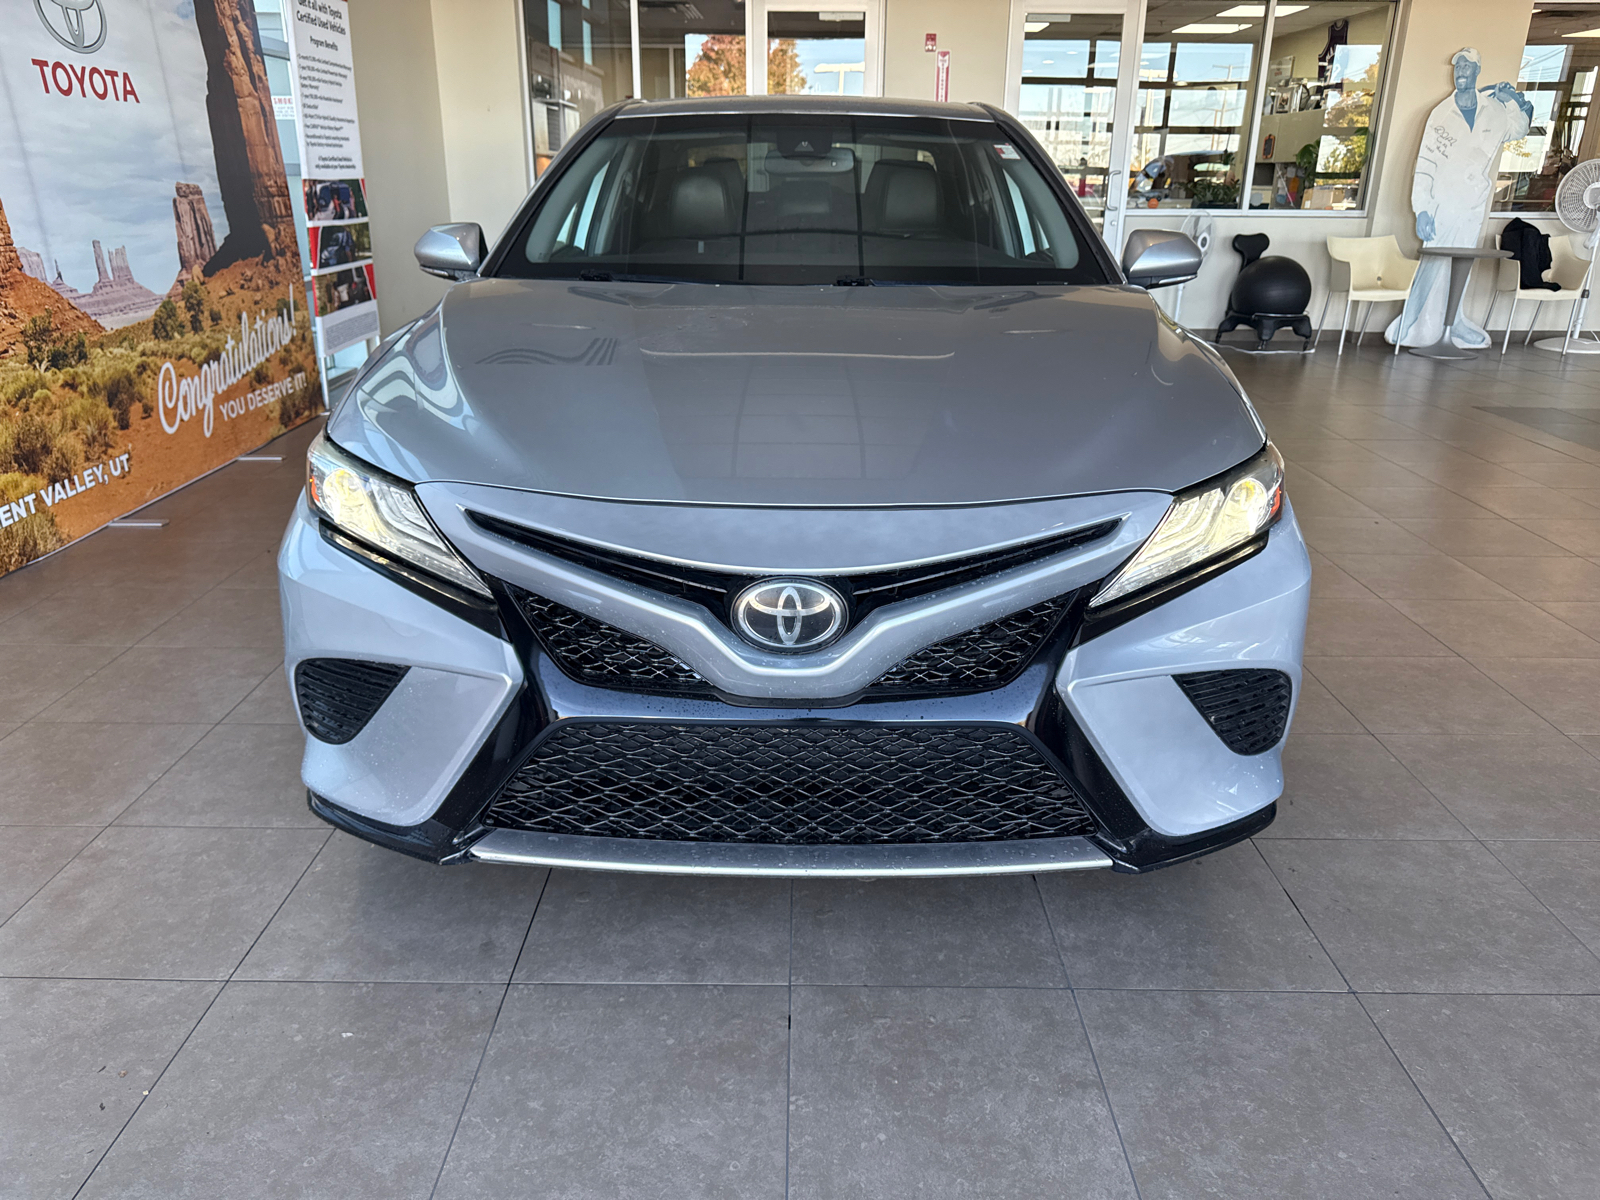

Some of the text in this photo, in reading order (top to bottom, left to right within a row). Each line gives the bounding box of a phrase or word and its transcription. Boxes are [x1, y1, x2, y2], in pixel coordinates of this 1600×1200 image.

[296, 10, 317, 26] Certified
[329, 20, 346, 36] Vehicles
[328, 5, 342, 20] Toyota
[31, 58, 140, 104] TOYOTA
[158, 282, 297, 438] Congratulations!
[219, 371, 307, 421] YOU DESERVE IT!
[0, 453, 129, 529] ENT VALLEY, UT
